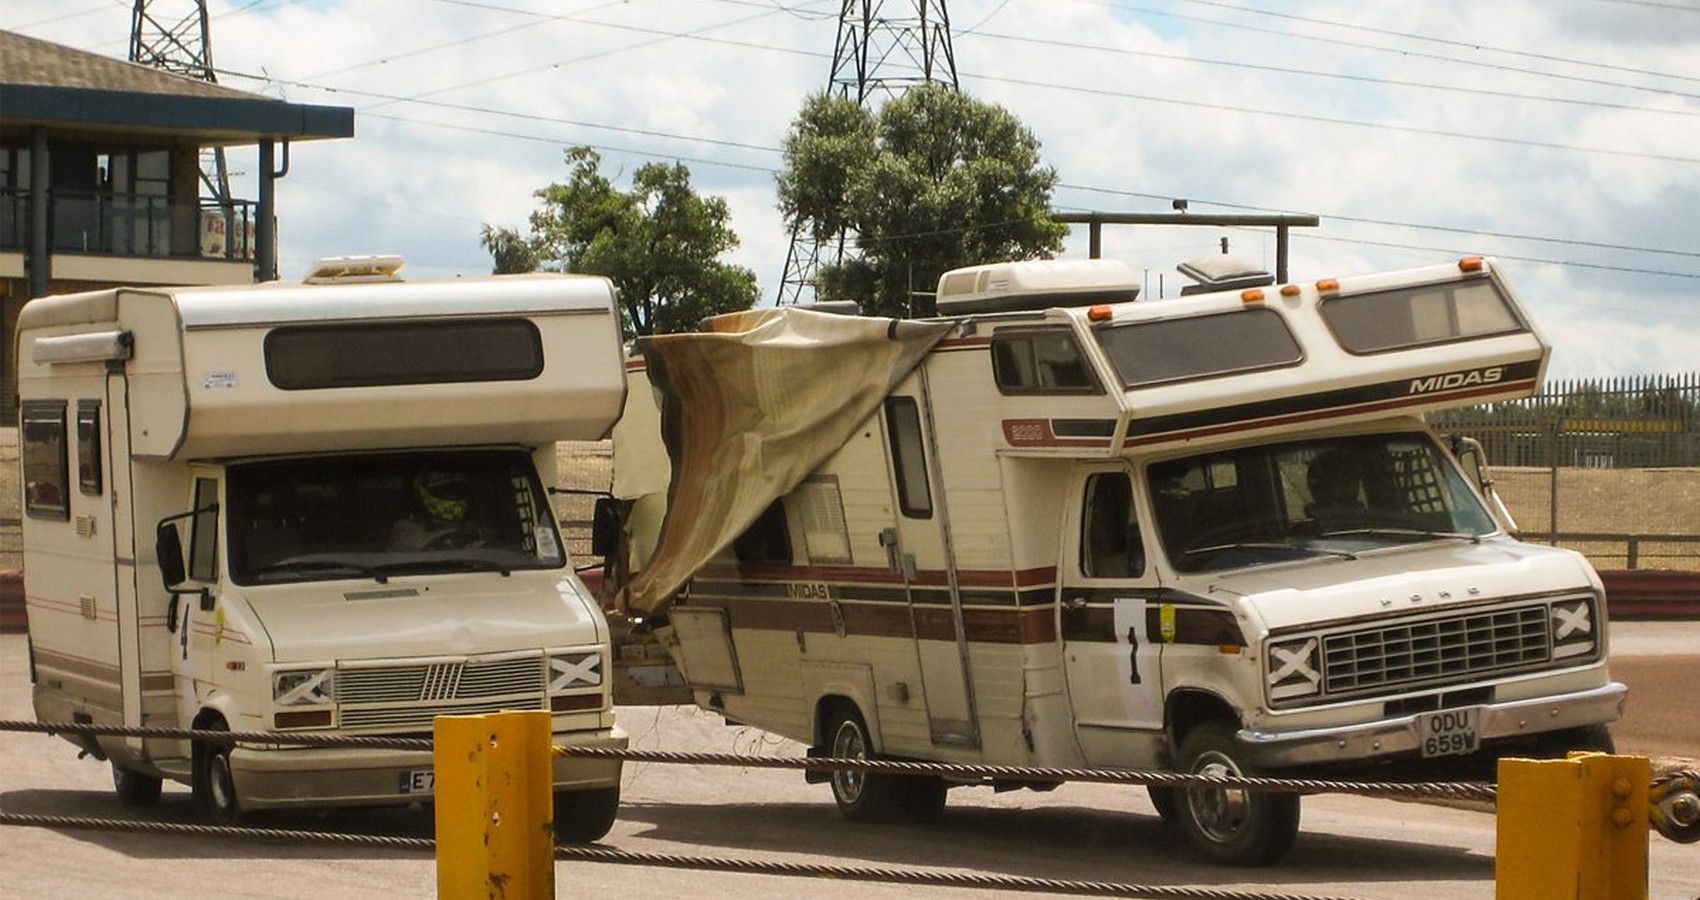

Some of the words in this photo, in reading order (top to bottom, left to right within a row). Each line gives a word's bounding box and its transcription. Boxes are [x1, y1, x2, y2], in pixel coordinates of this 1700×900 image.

[1409, 367, 1503, 394] MIDAS
[787, 583, 829, 599] MIDAS
[1127, 626, 1141, 684] 1
[1431, 710, 1468, 733] ODU
[1425, 731, 1476, 755] 659W
